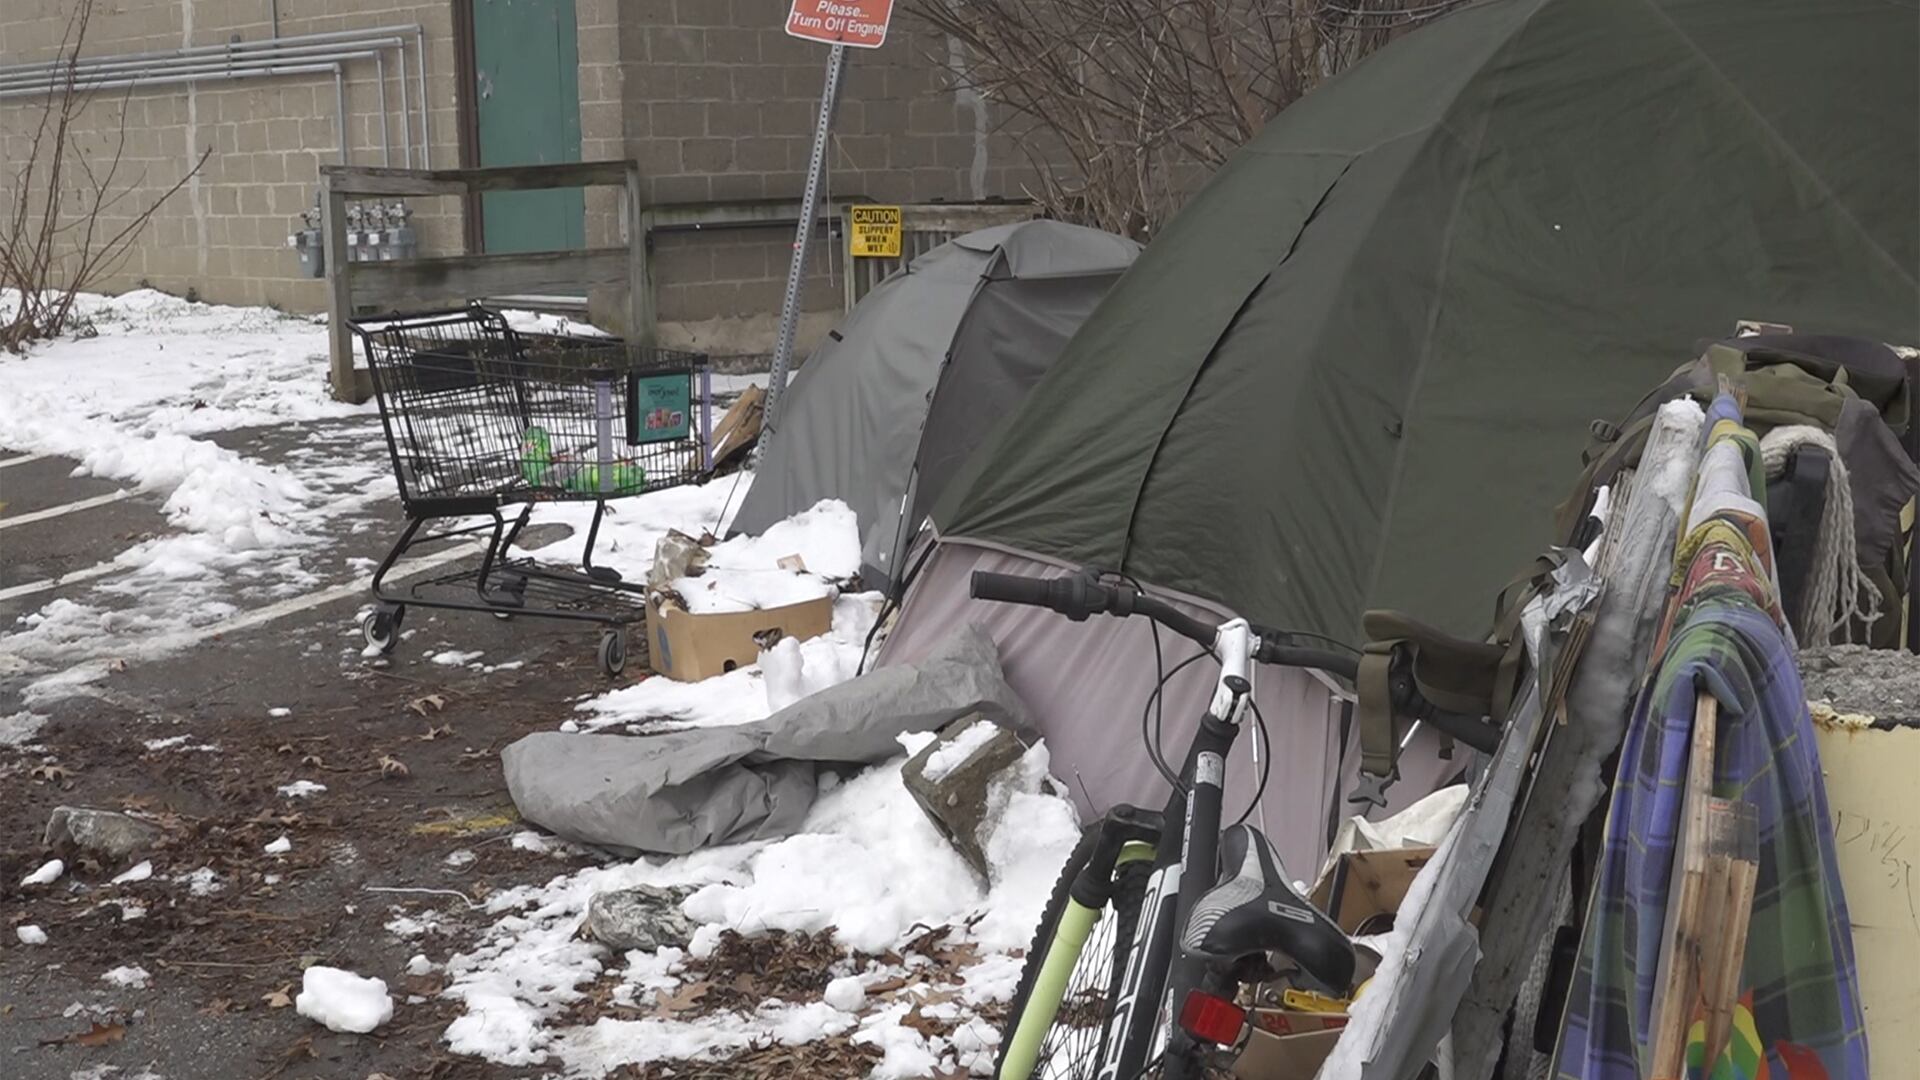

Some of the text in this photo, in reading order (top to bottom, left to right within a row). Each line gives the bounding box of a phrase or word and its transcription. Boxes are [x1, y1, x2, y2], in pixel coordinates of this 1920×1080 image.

[793, 12, 885, 37] Turn Off Engine
[854, 210, 898, 223] CAUTION
[858, 225, 894, 234] SLIPPERY
[865, 235, 887, 243] WHEN
[867, 244, 883, 253] WET
